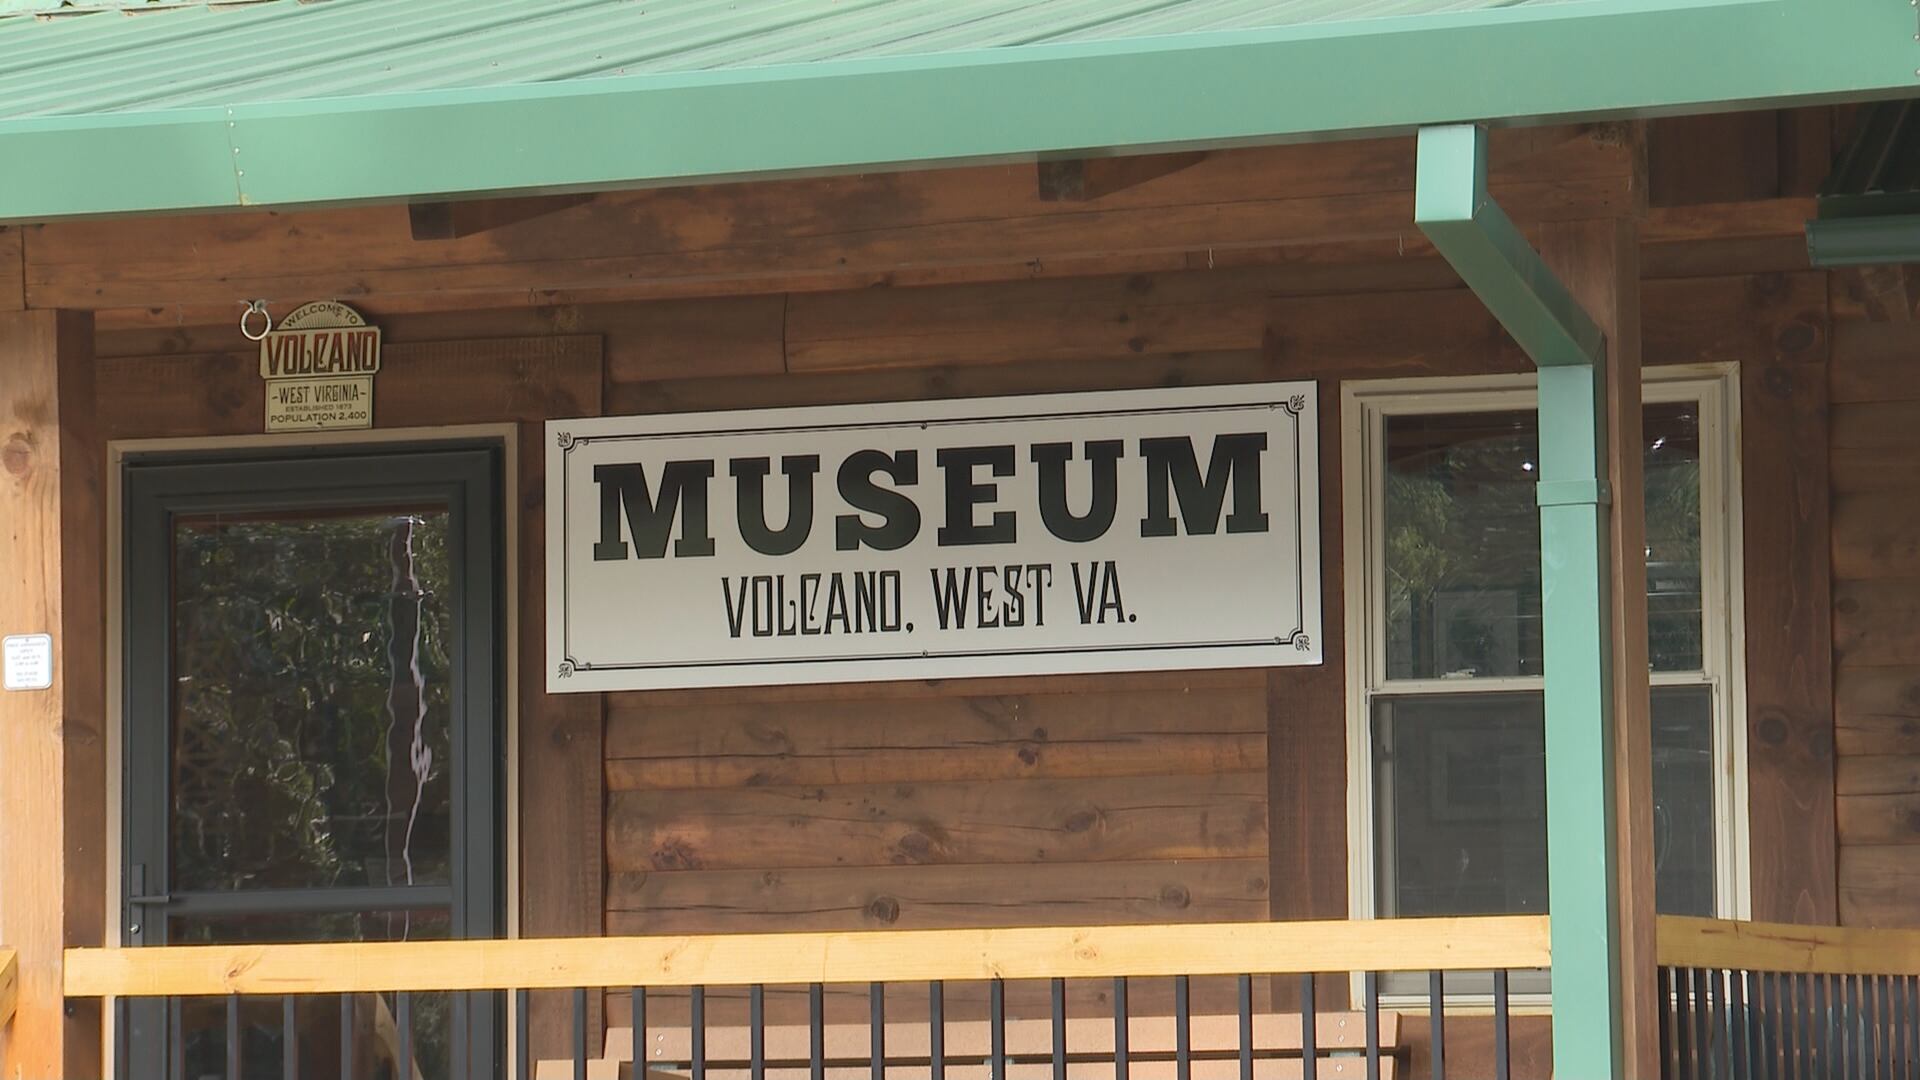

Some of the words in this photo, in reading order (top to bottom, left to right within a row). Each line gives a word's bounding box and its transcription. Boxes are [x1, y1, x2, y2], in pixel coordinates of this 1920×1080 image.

[285, 303, 344, 327] WELCOME
[345, 310, 358, 324] TO
[266, 331, 377, 375] VOLCANO
[270, 412, 336, 423] POPULATION
[338, 411, 367, 421] 2,400
[285, 404, 334, 412] ESTABLISHED
[592, 432, 1269, 561] MUSEUM
[721, 570, 915, 638] VOLCANO,
[930, 564, 1053, 630] WEST
[1072, 561, 1138, 625] VA.
